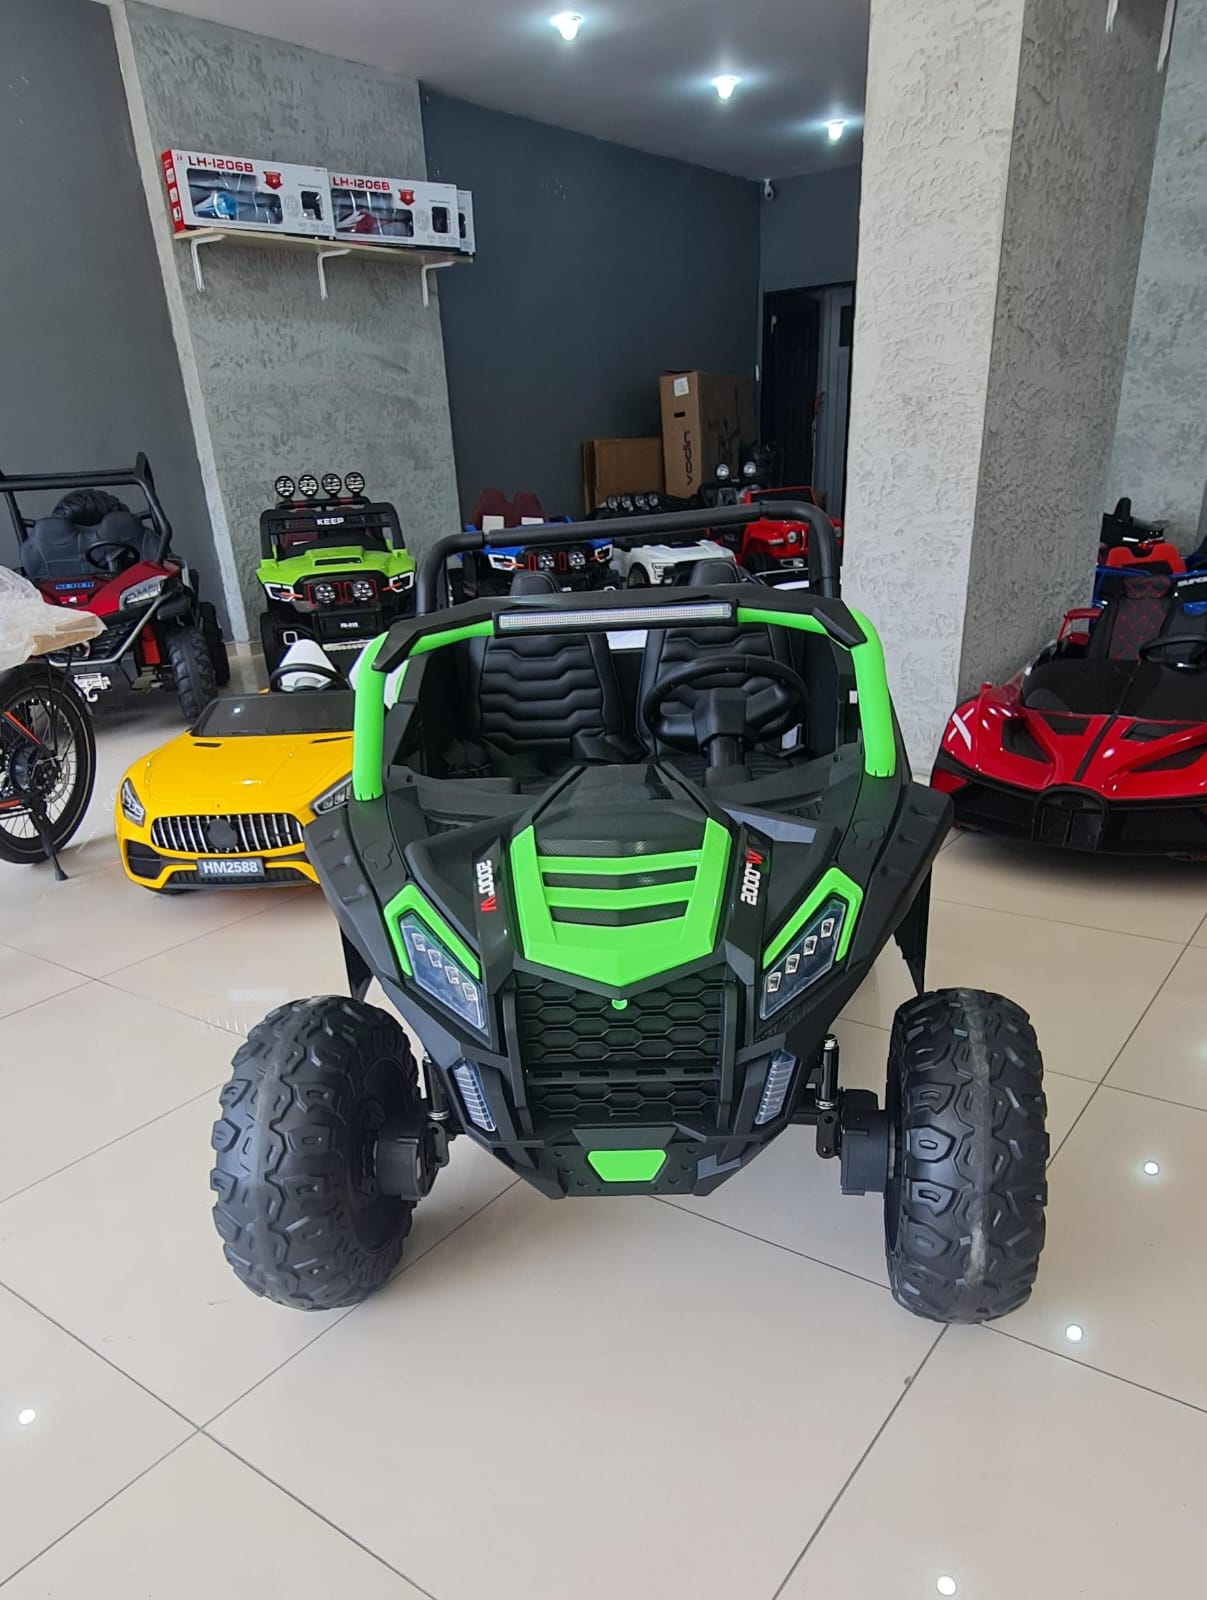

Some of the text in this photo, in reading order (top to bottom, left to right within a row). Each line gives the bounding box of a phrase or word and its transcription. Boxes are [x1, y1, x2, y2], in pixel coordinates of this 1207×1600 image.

[188, 155, 254, 173] LH-1206B
[332, 176, 390, 191] LH-1206B
[316, 517, 345, 526] KEEP
[202, 861, 259, 874] HM2588
